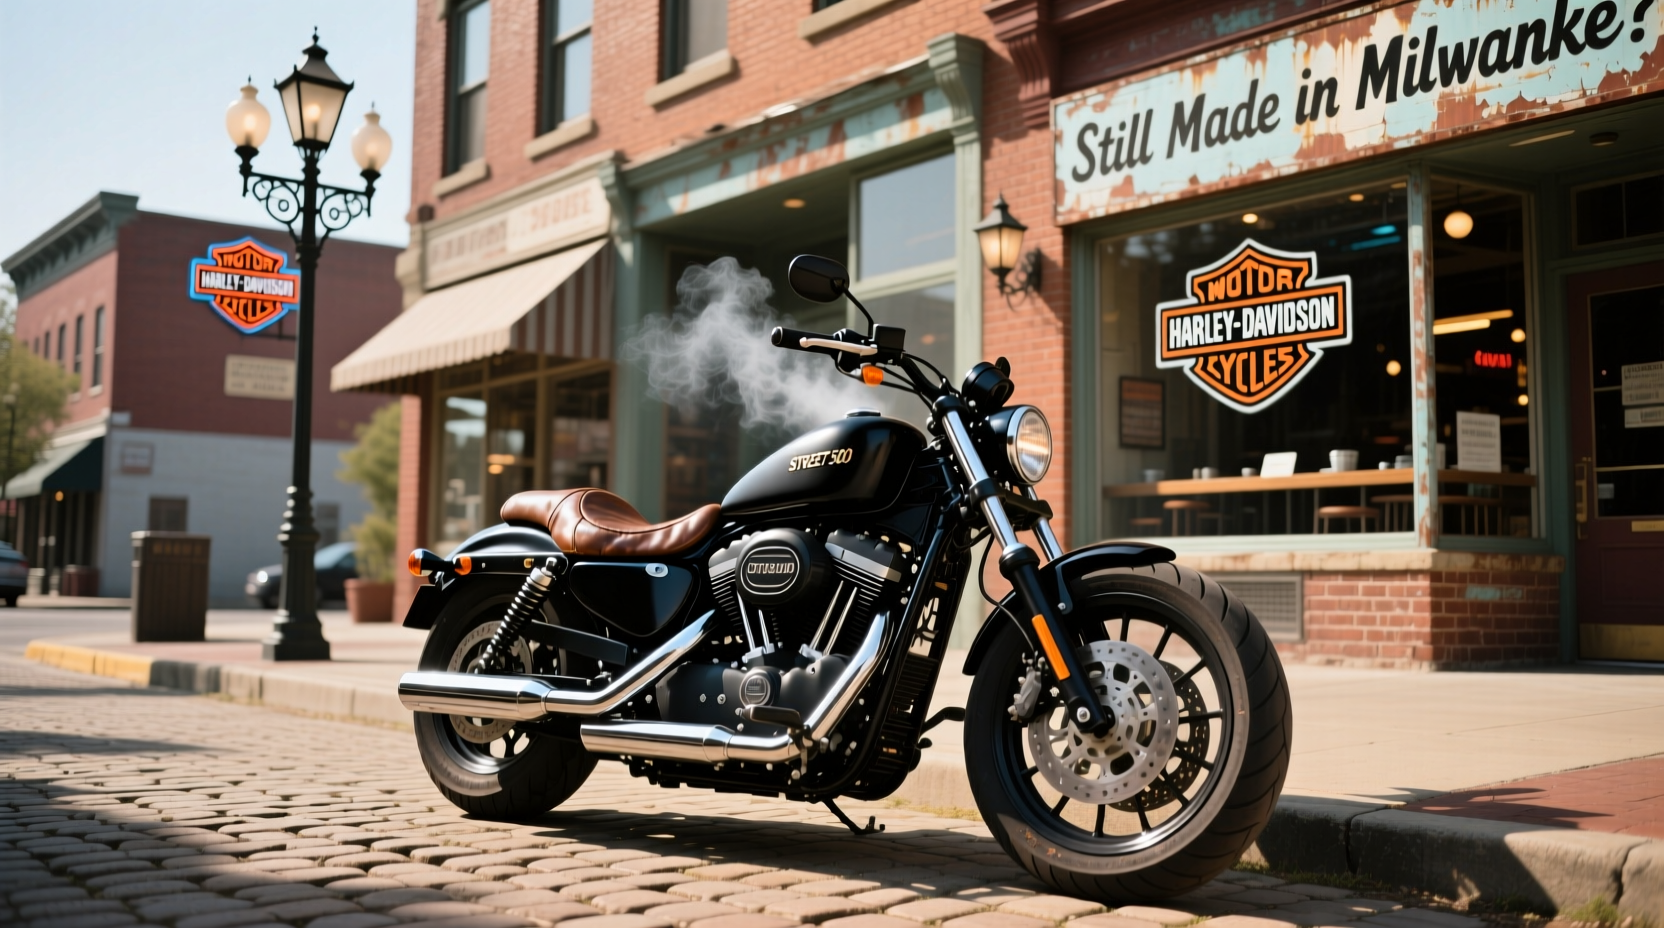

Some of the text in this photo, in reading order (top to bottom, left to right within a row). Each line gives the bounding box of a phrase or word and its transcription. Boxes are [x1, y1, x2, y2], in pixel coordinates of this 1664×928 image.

[1072, 108, 1154, 182] Still
[1166, 78, 1281, 159] Made
[1295, 68, 1340, 126] in
[1169, 295, 1335, 350] HARLEY-DAVIDSON
[1206, 346, 1294, 393] CYCLES
[828, 447, 853, 465] 500
